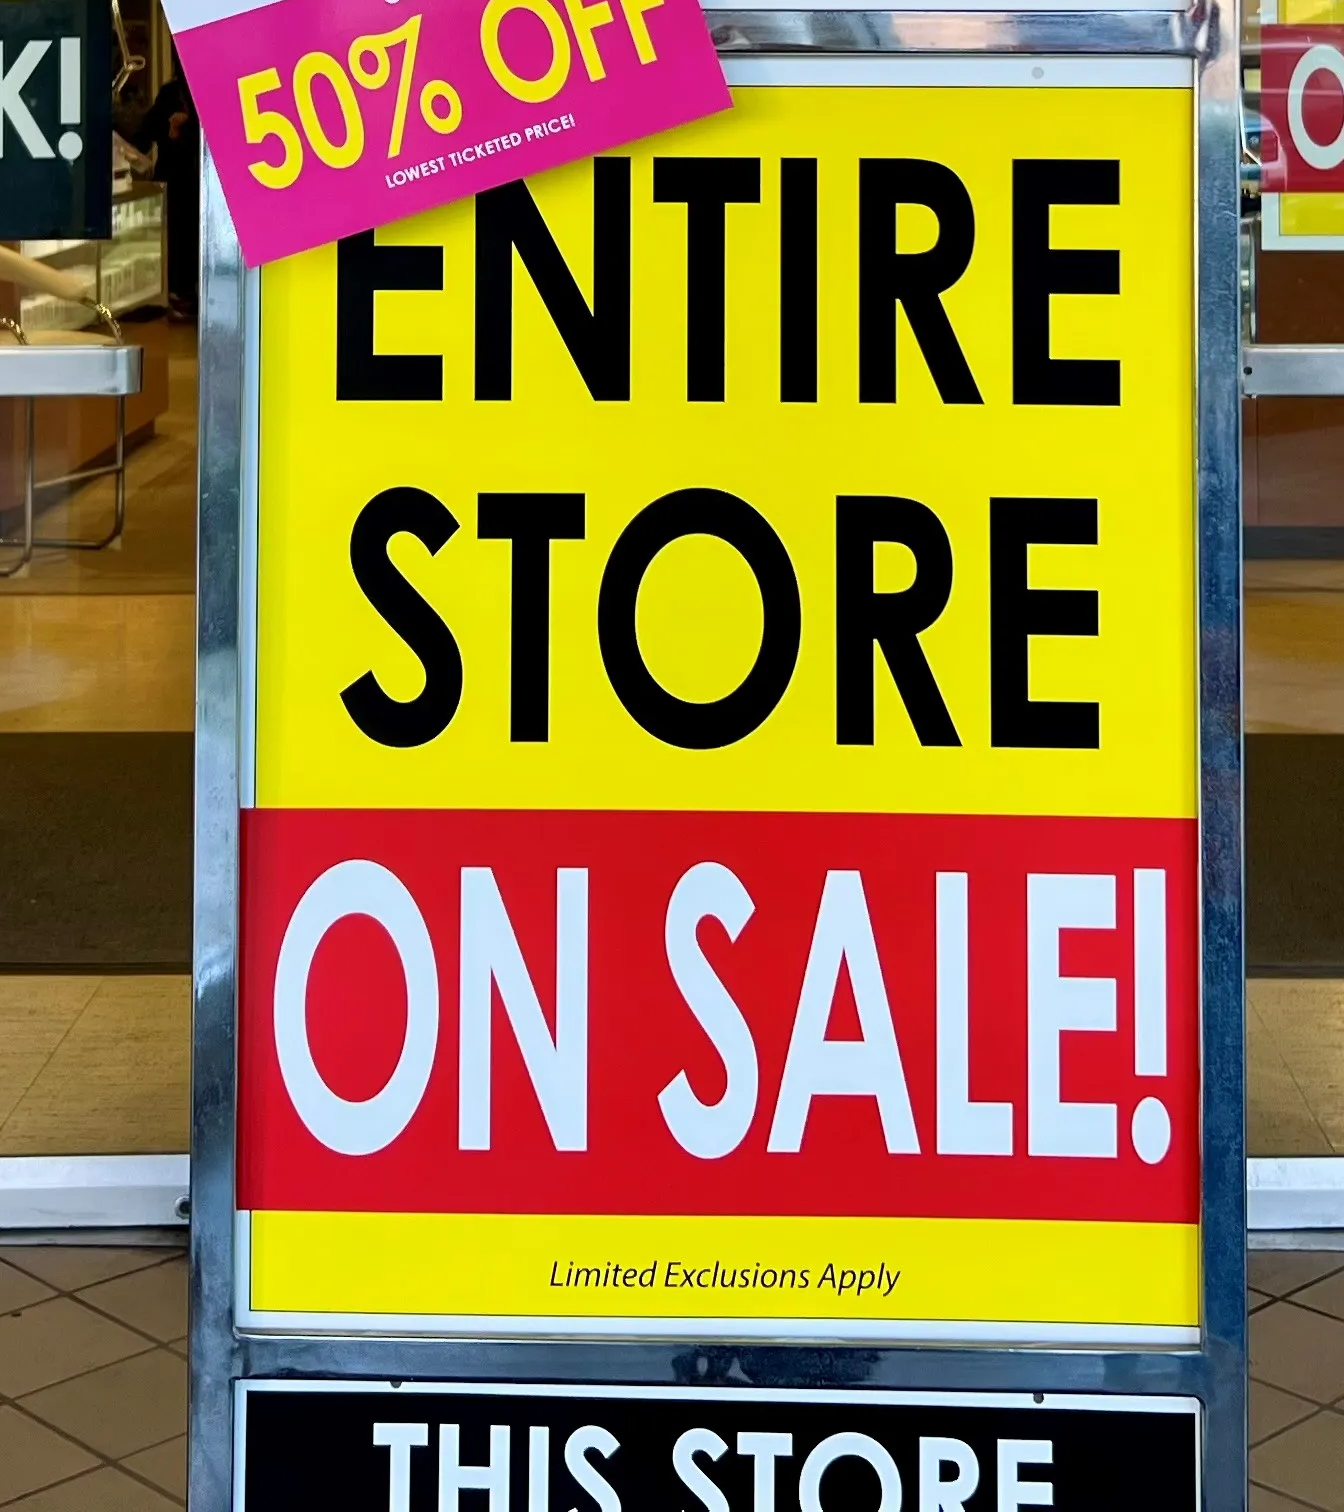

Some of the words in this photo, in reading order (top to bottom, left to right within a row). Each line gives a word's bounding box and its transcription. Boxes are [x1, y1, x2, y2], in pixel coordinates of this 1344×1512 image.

[236, 15, 462, 189] 50%
[385, 155, 445, 189] LOWEST
[448, 133, 521, 171] TICKETED
[523, 114, 575, 150] PRICE!
[335, 156, 1122, 407] ENTIRE
[338, 485, 1100, 750] STORE
[273, 859, 589, 1157] ON
[657, 860, 1172, 1166] SALE!
[550, 1259, 656, 1290] Limited
[664, 1260, 810, 1290] Exclusions
[816, 1262, 901, 1297] Apply
[372, 1423, 623, 1512] THIS
[672, 1428, 1054, 1512] STORE
